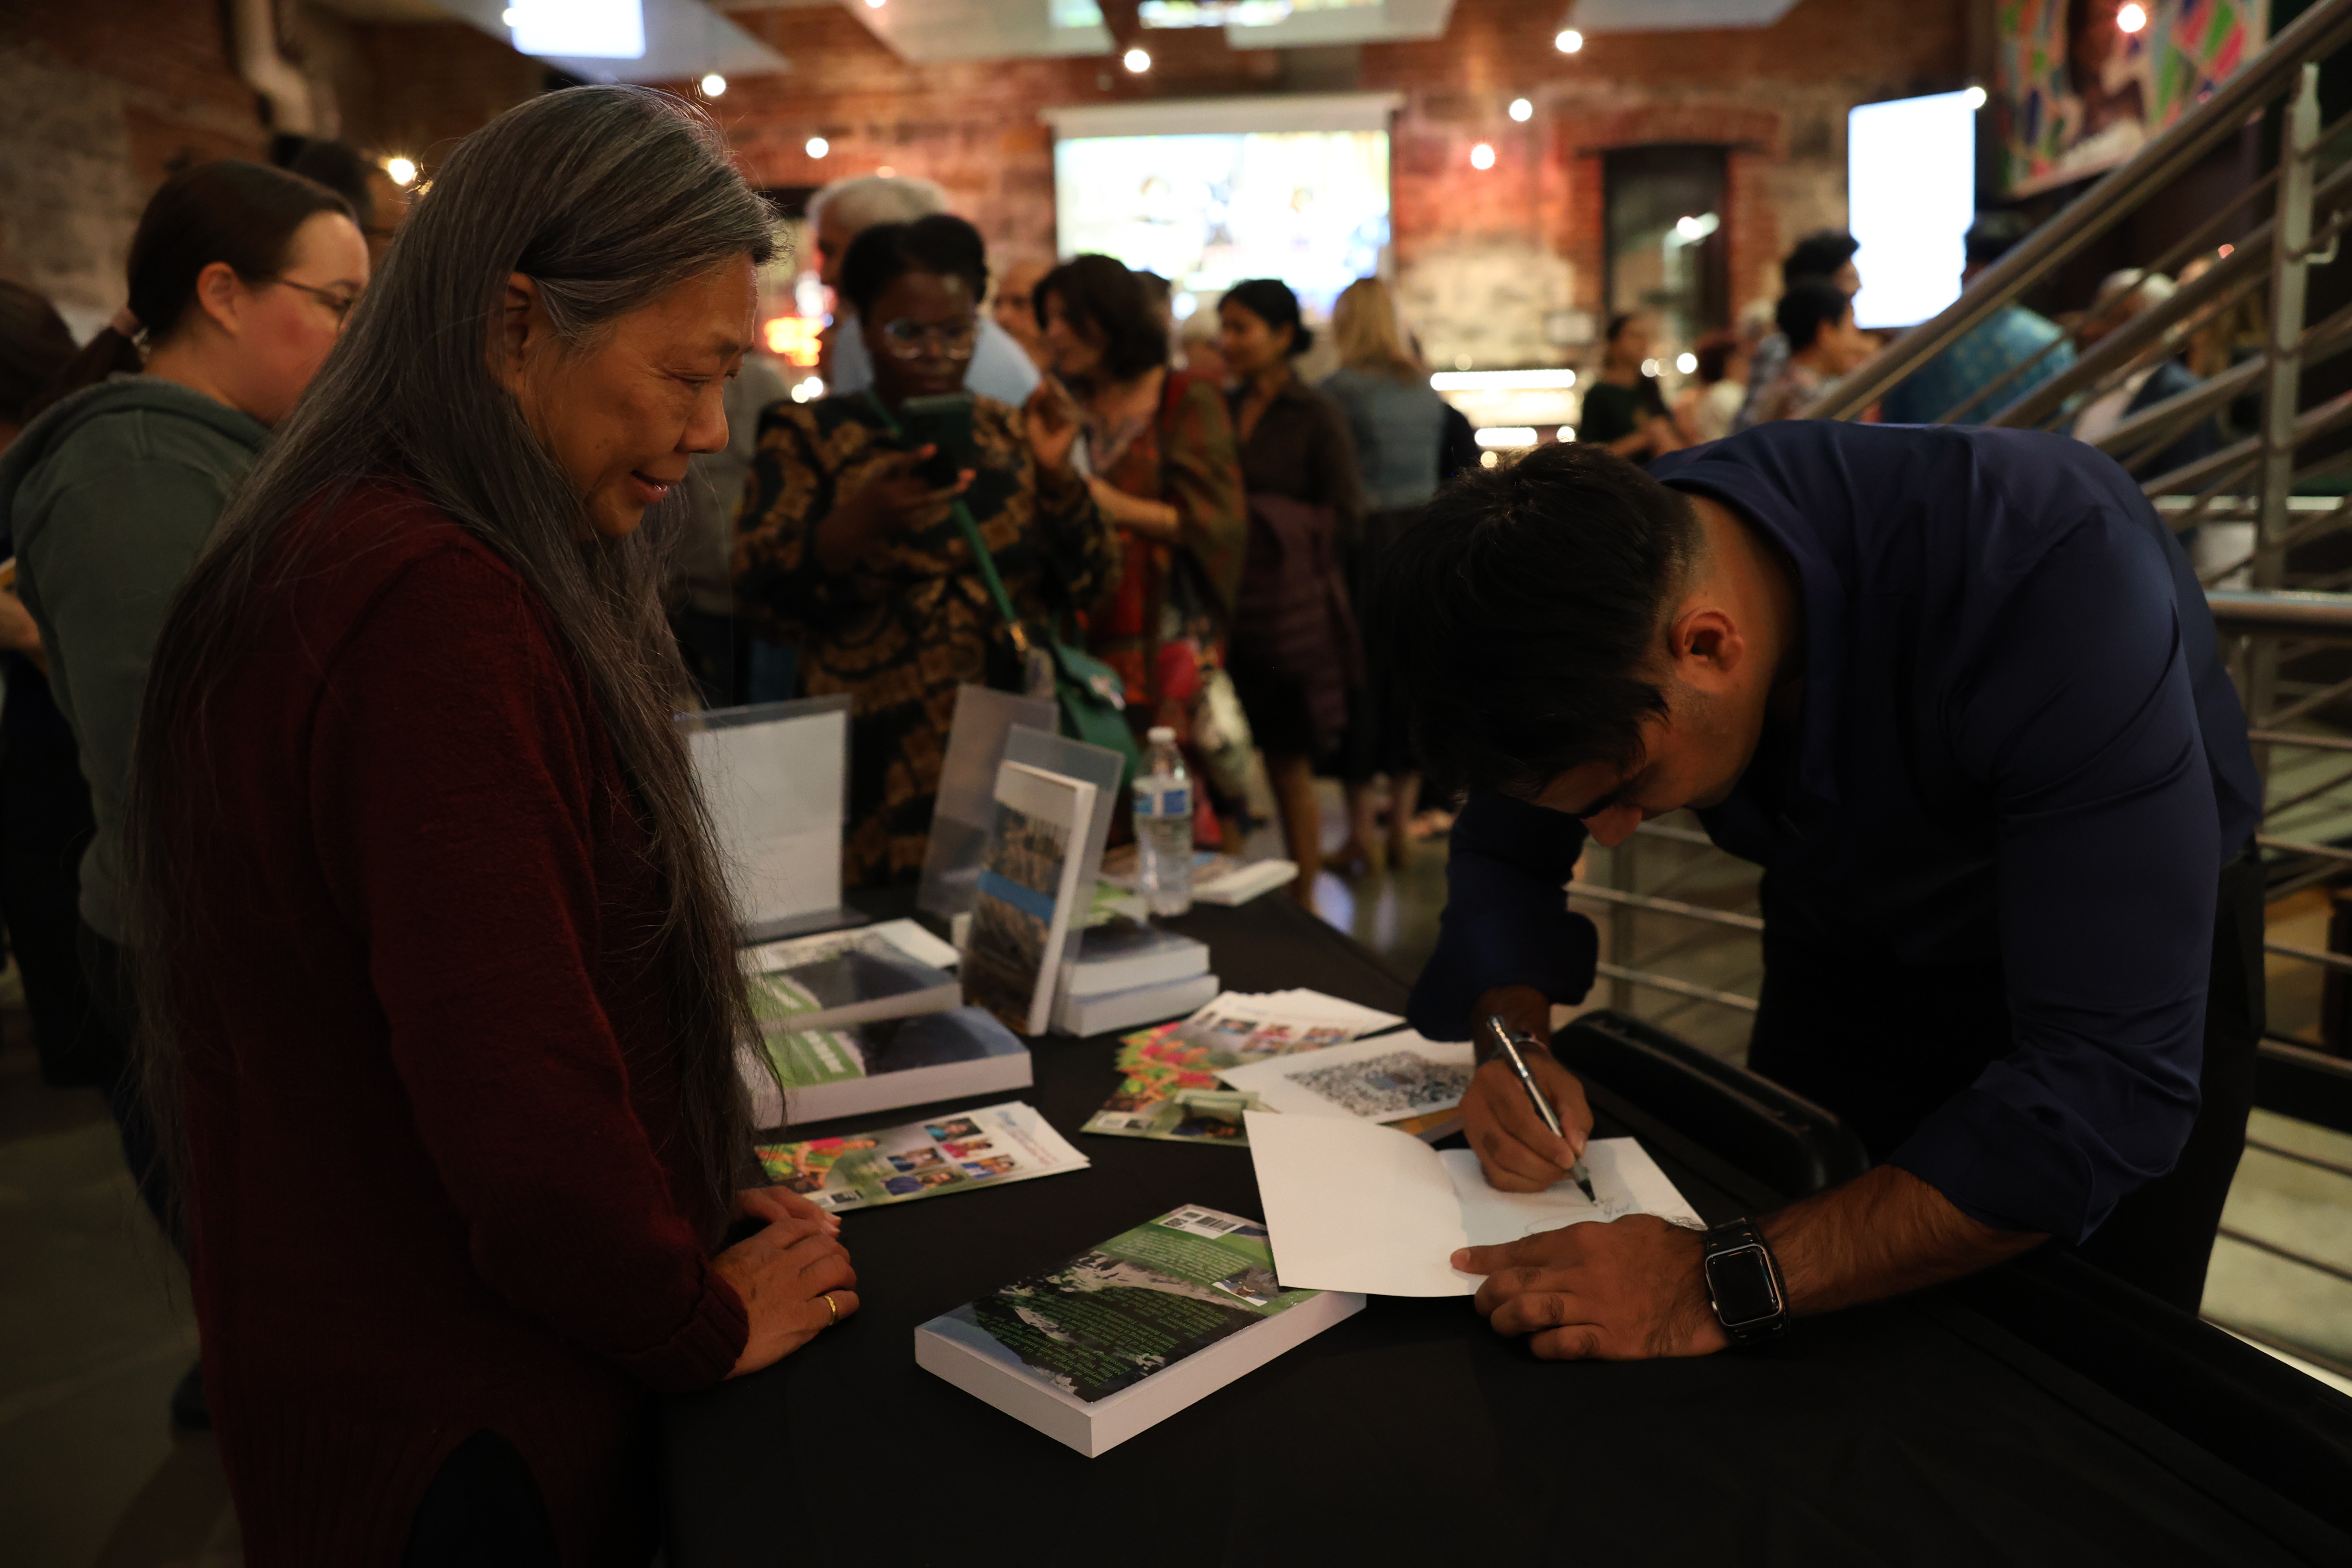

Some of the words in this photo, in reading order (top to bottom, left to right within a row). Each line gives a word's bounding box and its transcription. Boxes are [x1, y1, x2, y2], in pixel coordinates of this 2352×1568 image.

[1189, 1307, 1207, 1316] never
[1116, 1313, 1138, 1324] Friend
[1156, 1318, 1179, 1330] twenty
[1192, 1315, 1217, 1328] military
[1206, 1315, 1224, 1325] must
[1096, 1324, 1123, 1336] journey
[1109, 1323, 1124, 1332] hero
[1167, 1316, 1203, 1334] interpreters
[1011, 1334, 1040, 1348] American
[1025, 1334, 1053, 1347] Assistant
[1077, 1330, 1111, 1346] fascinated
[1128, 1331, 1147, 1343] being
[1148, 1334, 1175, 1348] America
[1054, 1347, 1077, 1359] Former
[1072, 1348, 1096, 1360] combat
[1138, 1344, 1160, 1356] details
[1052, 1353, 1069, 1362] fight
[1097, 1352, 1131, 1371] bestselling
[1052, 1361, 1072, 1371] heart
[1100, 1362, 1123, 1375] Marine
[1074, 1363, 1108, 1382] everything
[1084, 1376, 1101, 1387] John
